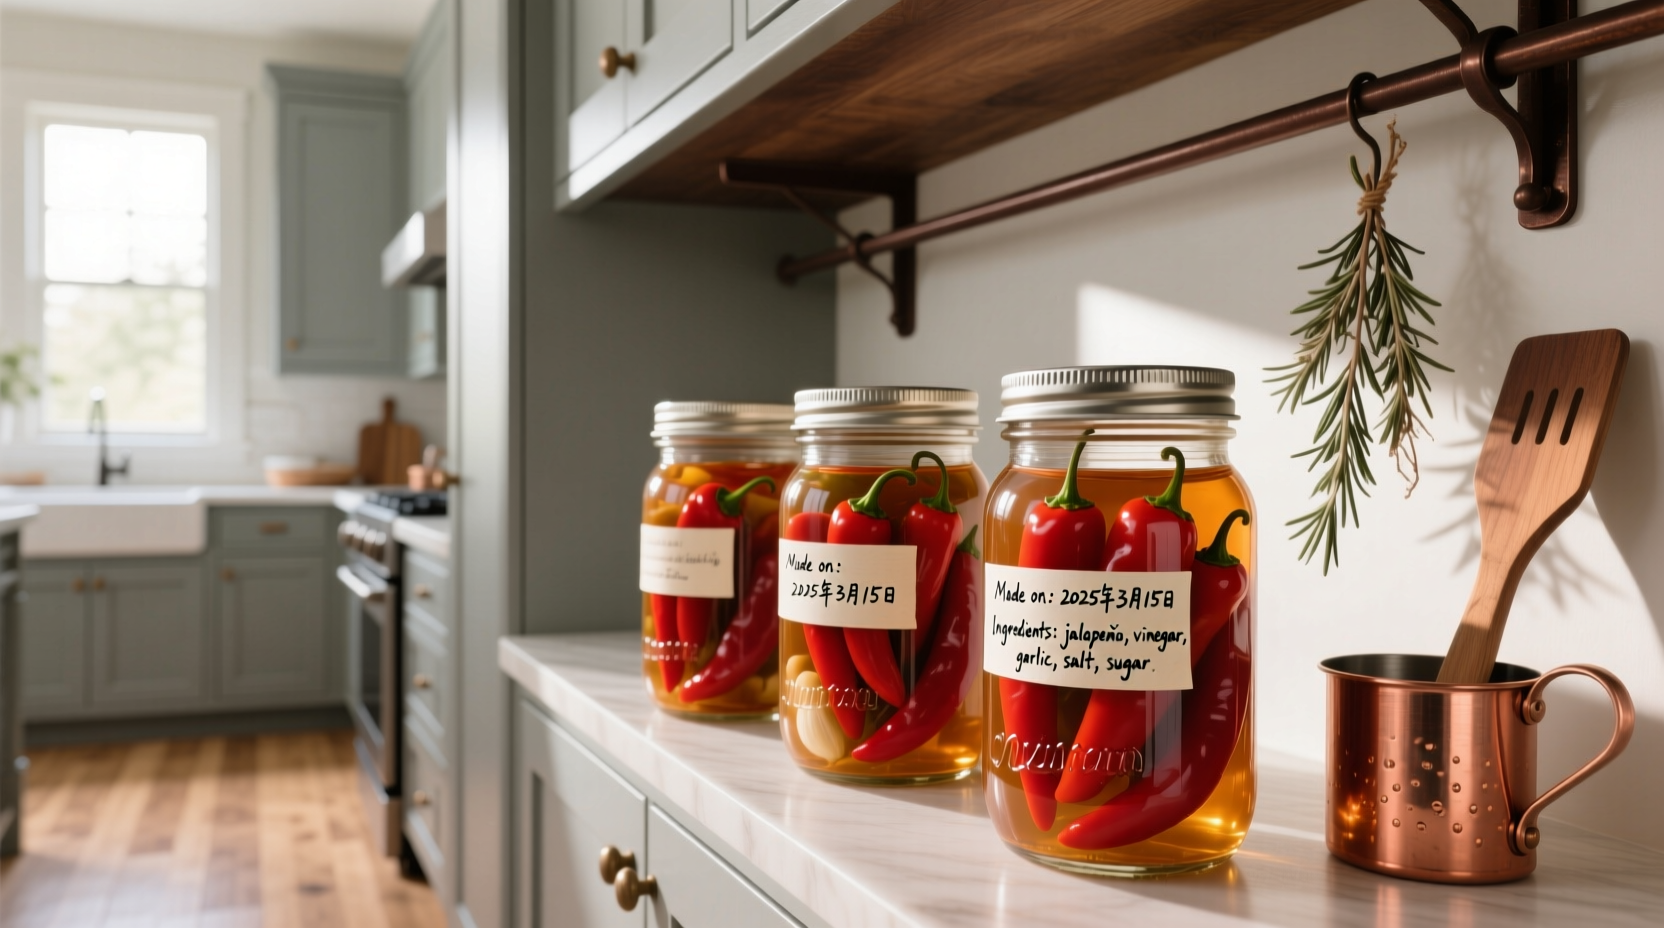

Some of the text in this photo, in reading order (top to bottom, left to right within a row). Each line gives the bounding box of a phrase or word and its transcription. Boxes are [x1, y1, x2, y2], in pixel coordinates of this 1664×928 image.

[818, 561, 841, 573] on:
[995, 580, 1174, 613] Made on: 2025年3月15日
[992, 615, 1057, 645] Ingredients:
[1133, 627, 1187, 652] vinegar,
[1016, 647, 1058, 672] garlic,
[1063, 650, 1099, 674] salt,
